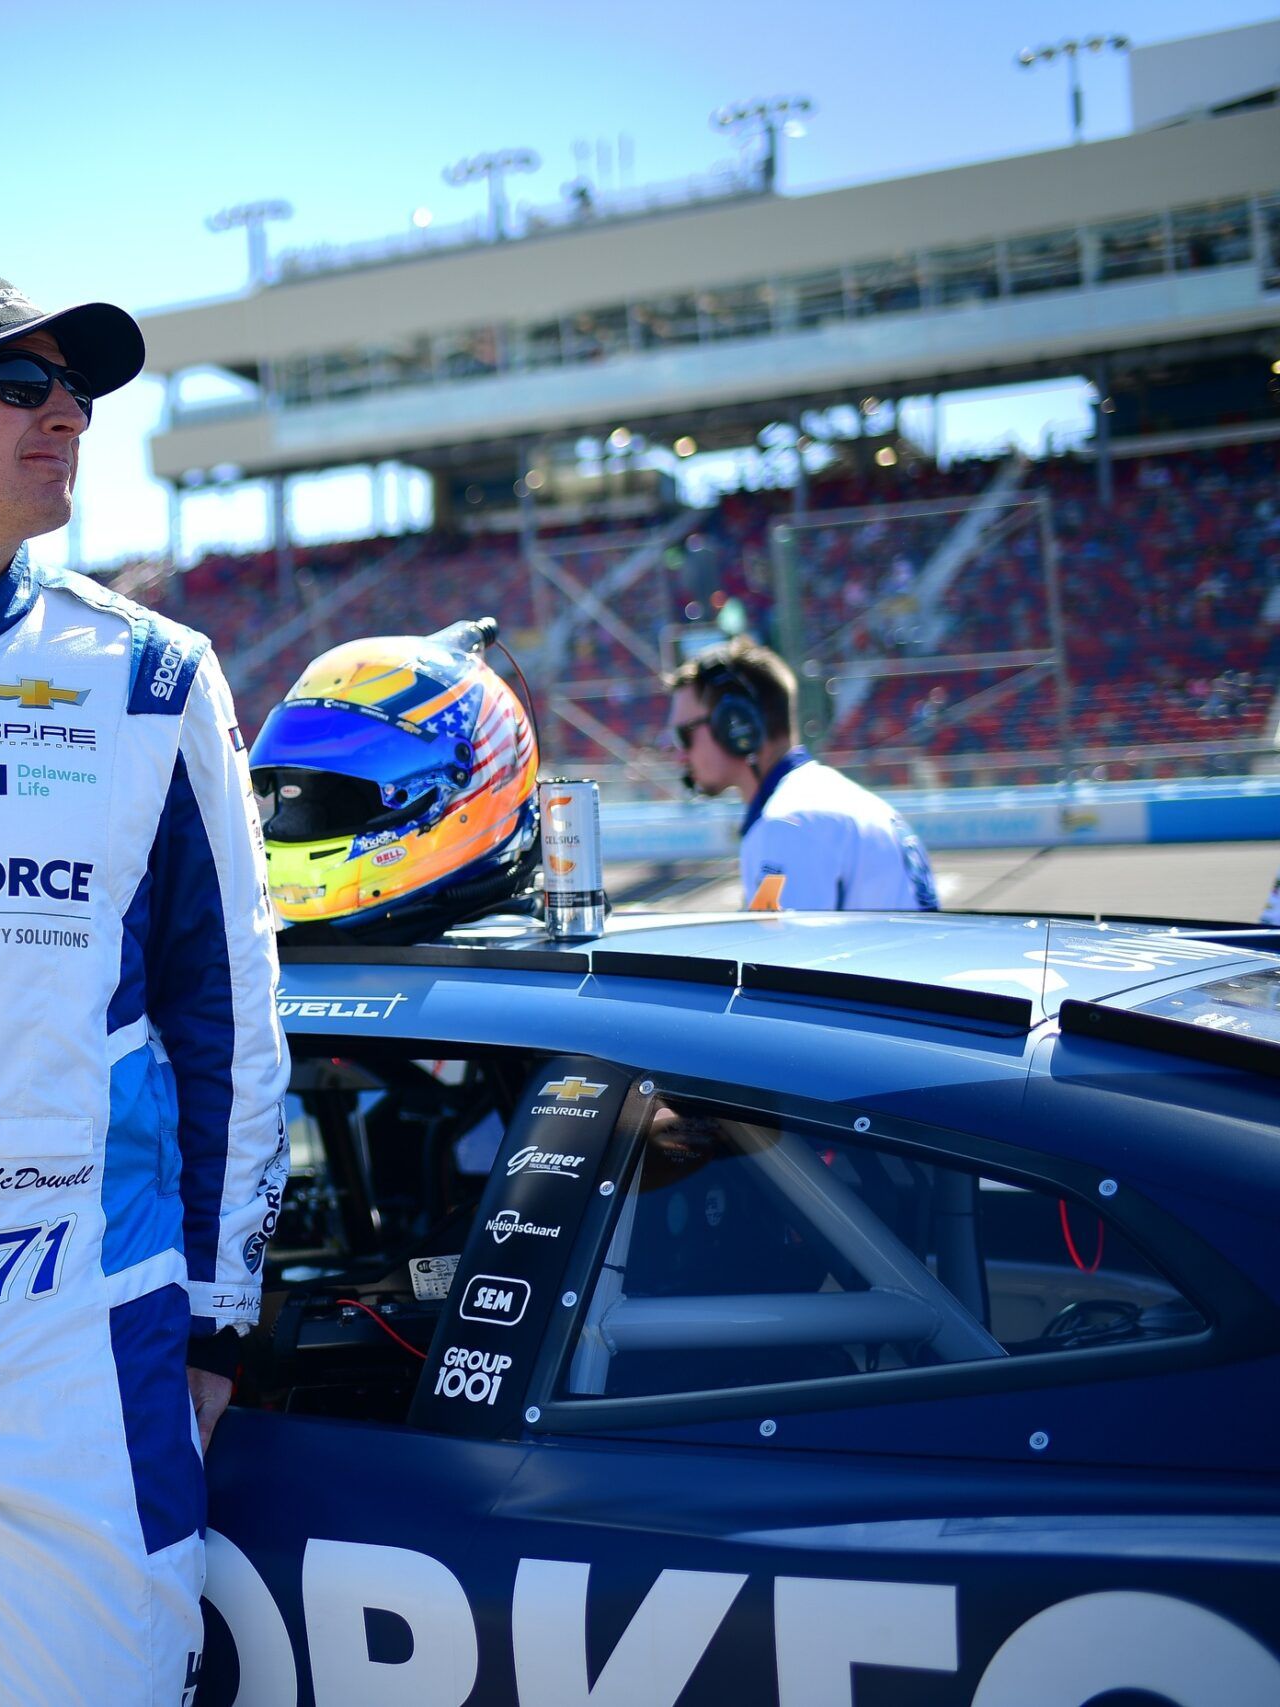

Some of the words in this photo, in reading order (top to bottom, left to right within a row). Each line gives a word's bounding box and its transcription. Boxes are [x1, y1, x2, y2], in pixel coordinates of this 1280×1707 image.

[17, 764, 97, 784] Delaware
[18, 782, 50, 797] Life
[545, 835, 580, 844] CELSIUS
[376, 849, 403, 863] BELL
[15, 928, 89, 949] SOLUTIONS
[531, 1106, 599, 1118] CHEVROLET
[507, 1146, 585, 1176] Garner
[485, 1219, 561, 1238] NationsGuard
[212, 1295, 235, 1308] I
[473, 1286, 514, 1312] SEM
[443, 1346, 512, 1374] GROUP
[434, 1366, 502, 1405] 1001
